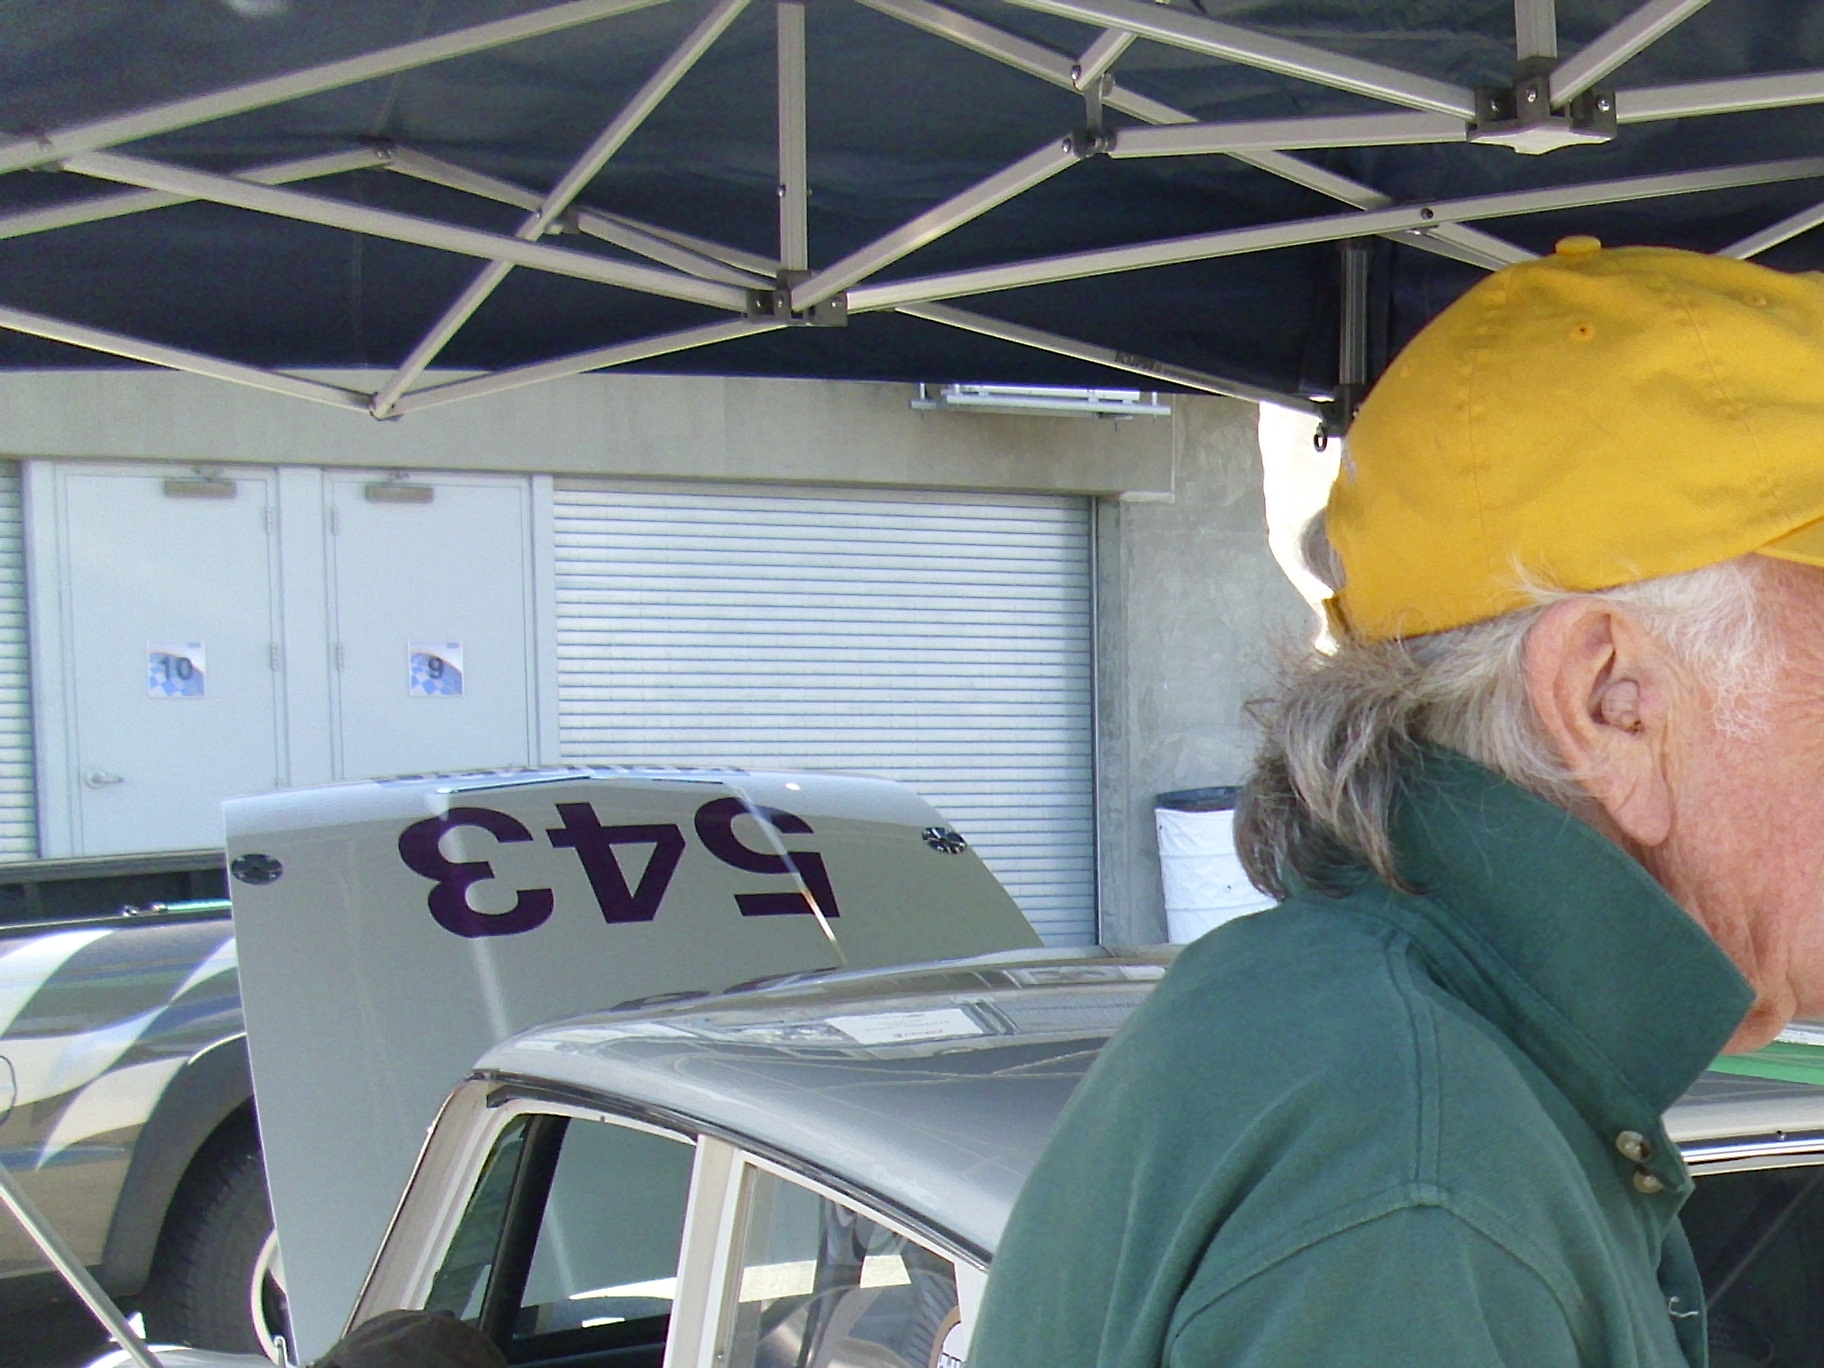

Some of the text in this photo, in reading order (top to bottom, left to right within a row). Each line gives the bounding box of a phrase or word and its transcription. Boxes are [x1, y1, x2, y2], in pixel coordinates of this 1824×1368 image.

[158, 656, 194, 681] 10
[427, 655, 444, 679] 9
[398, 797, 840, 938] 543
